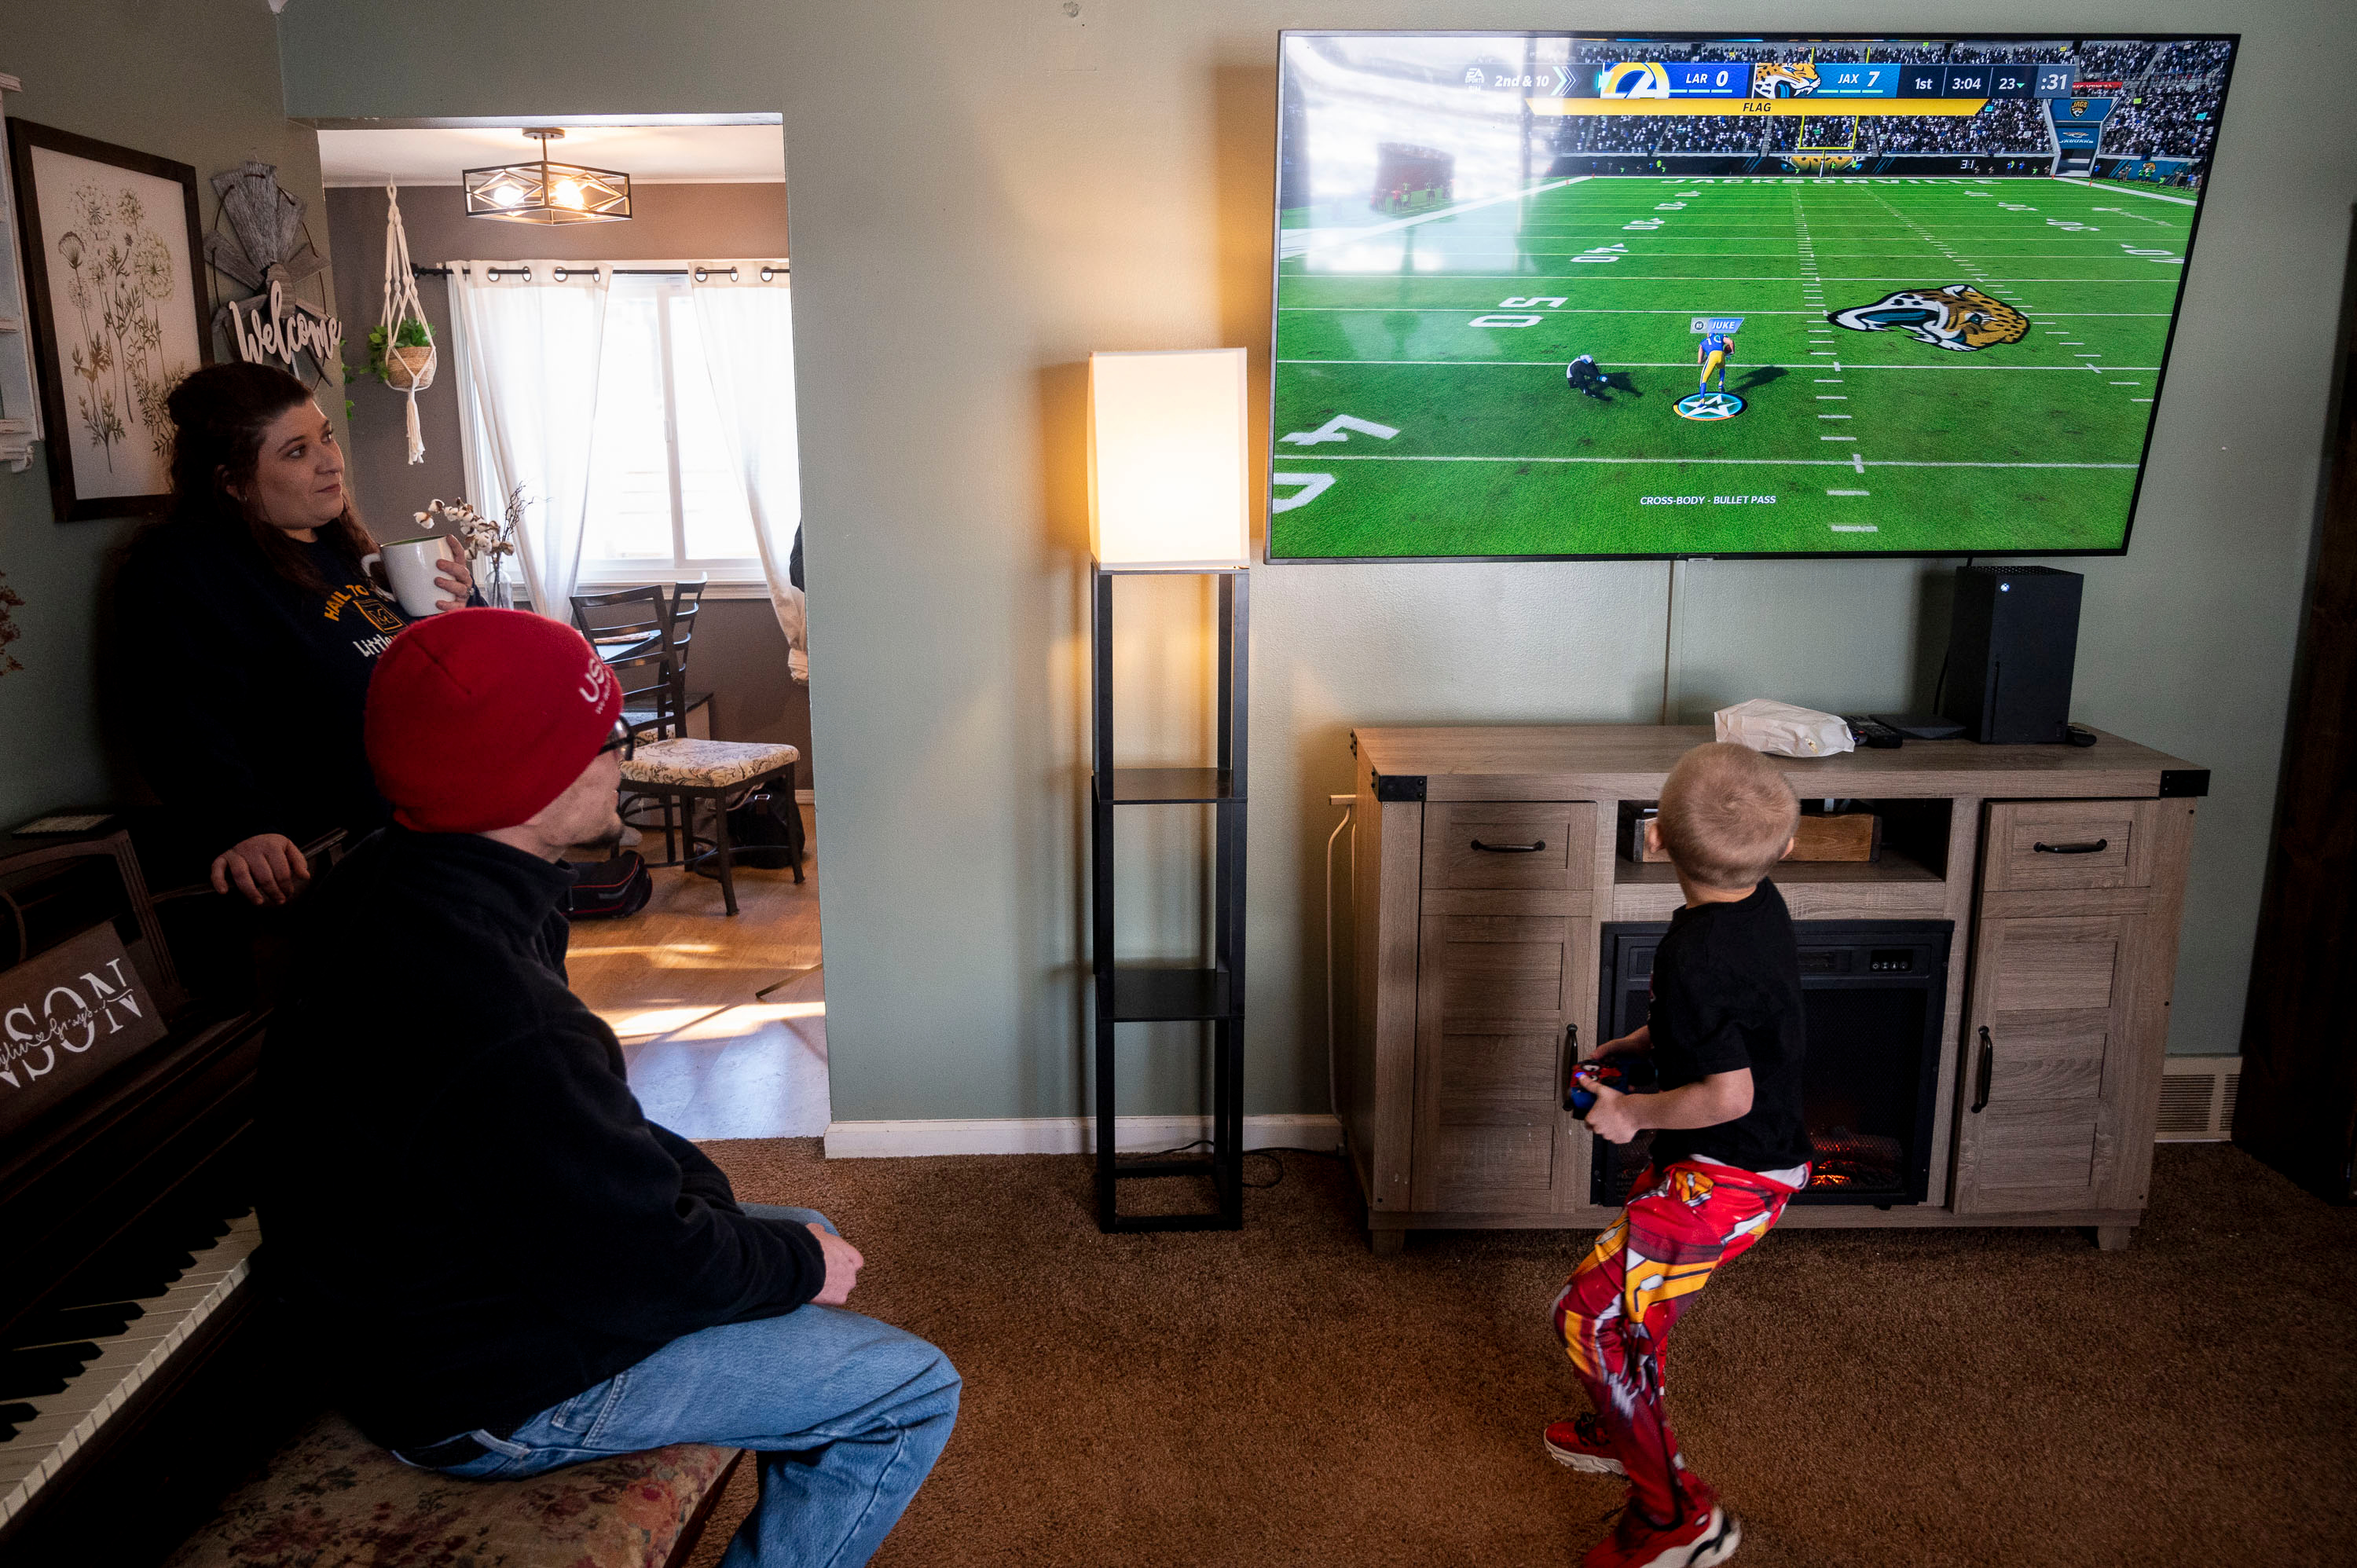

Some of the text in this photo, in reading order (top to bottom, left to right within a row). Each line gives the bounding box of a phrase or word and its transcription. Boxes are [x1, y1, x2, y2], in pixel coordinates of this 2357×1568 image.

[1466, 68, 1484, 78] EA
[1684, 71, 1728, 86] LAR 0
[1837, 71, 1880, 87] JAX 7
[1494, 75, 1550, 87] 2nd & 10
[1914, 74, 2068, 90] 1st 3:04 23 :31
[1743, 103, 1772, 112] FLAG
[229, 280, 342, 365] Welcome
[1711, 321, 1736, 330] JUKE
[1640, 496, 1706, 505] CROSS-BODY
[1713, 496, 1750, 504] BULLET
[1751, 496, 1776, 504] PASS
[324, 584, 370, 621] HAIL TO
[0, 958, 142, 1088] SON
